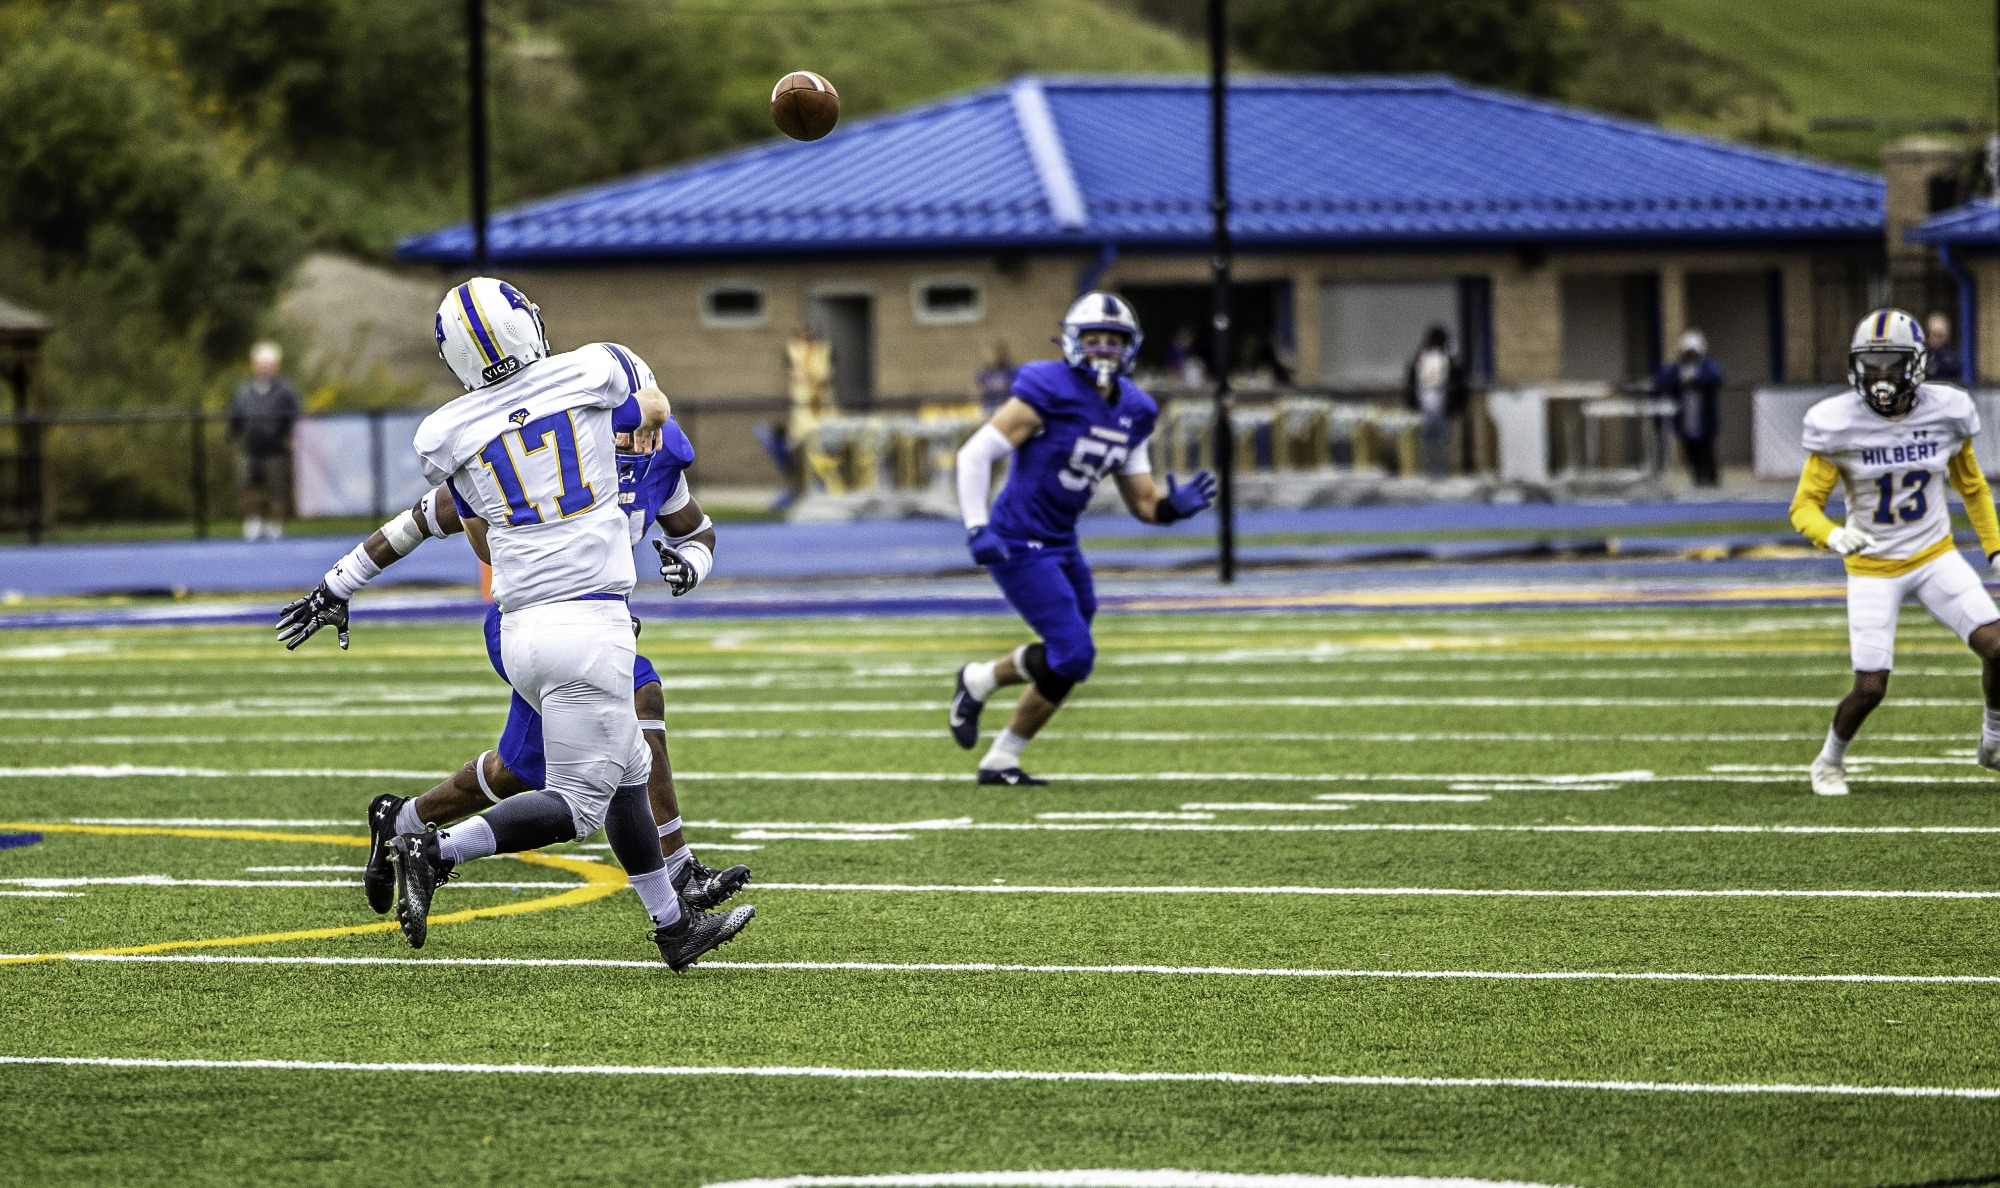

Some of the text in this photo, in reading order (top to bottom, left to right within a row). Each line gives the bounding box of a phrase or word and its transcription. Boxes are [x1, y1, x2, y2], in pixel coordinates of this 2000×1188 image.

[484, 358, 516, 379] VICIS
[477, 409, 596, 528] 17
[1861, 442, 1939, 466] HILBERT
[1872, 468, 1932, 525] 13
